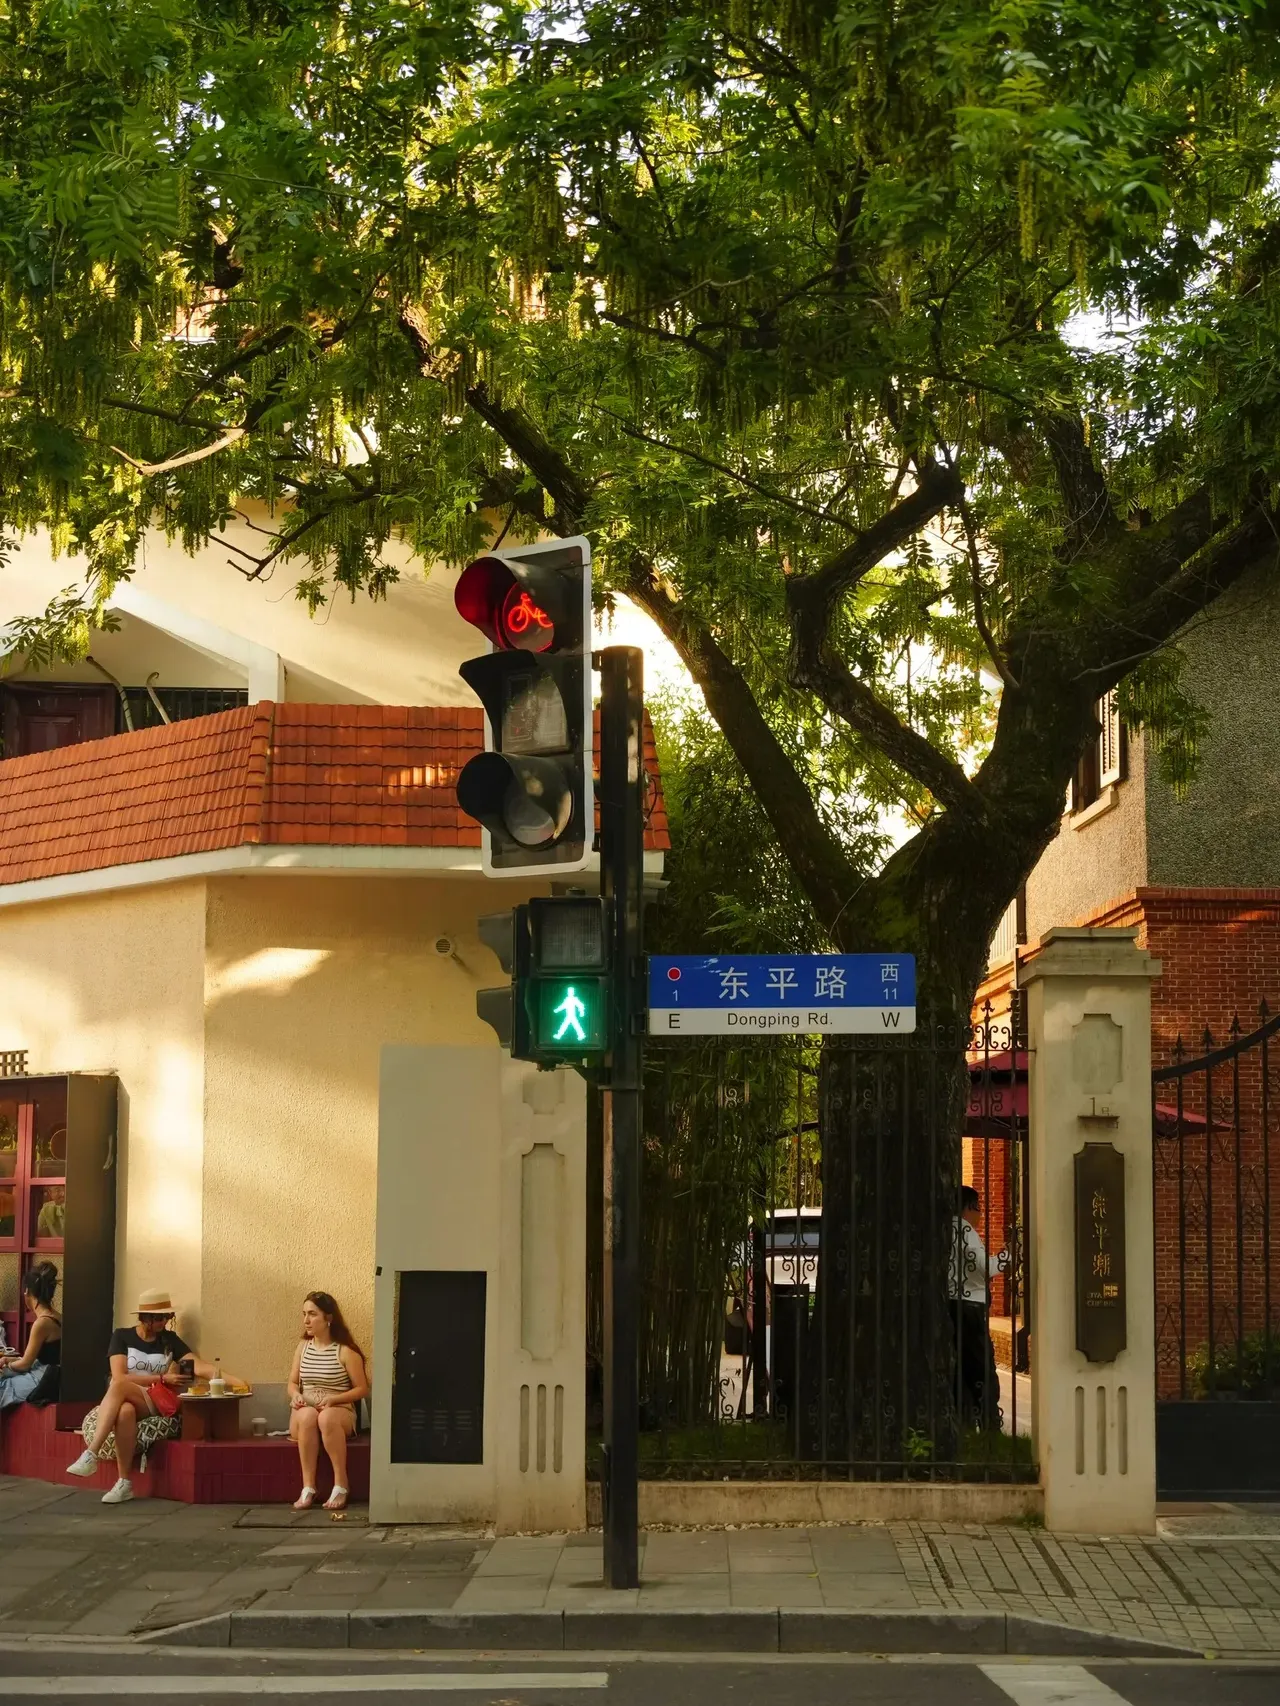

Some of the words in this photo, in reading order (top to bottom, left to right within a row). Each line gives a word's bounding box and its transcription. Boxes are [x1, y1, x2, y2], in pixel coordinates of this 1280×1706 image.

[880, 963, 899, 983] 西
[718, 966, 848, 1000] 东平路
[672, 989, 678, 1001] 1
[883, 988, 897, 1000] 11
[669, 1013, 681, 1029] E
[727, 1012, 800, 1028] Dongping
[808, 1012, 833, 1025] Rd.
[882, 1012, 900, 1027] W
